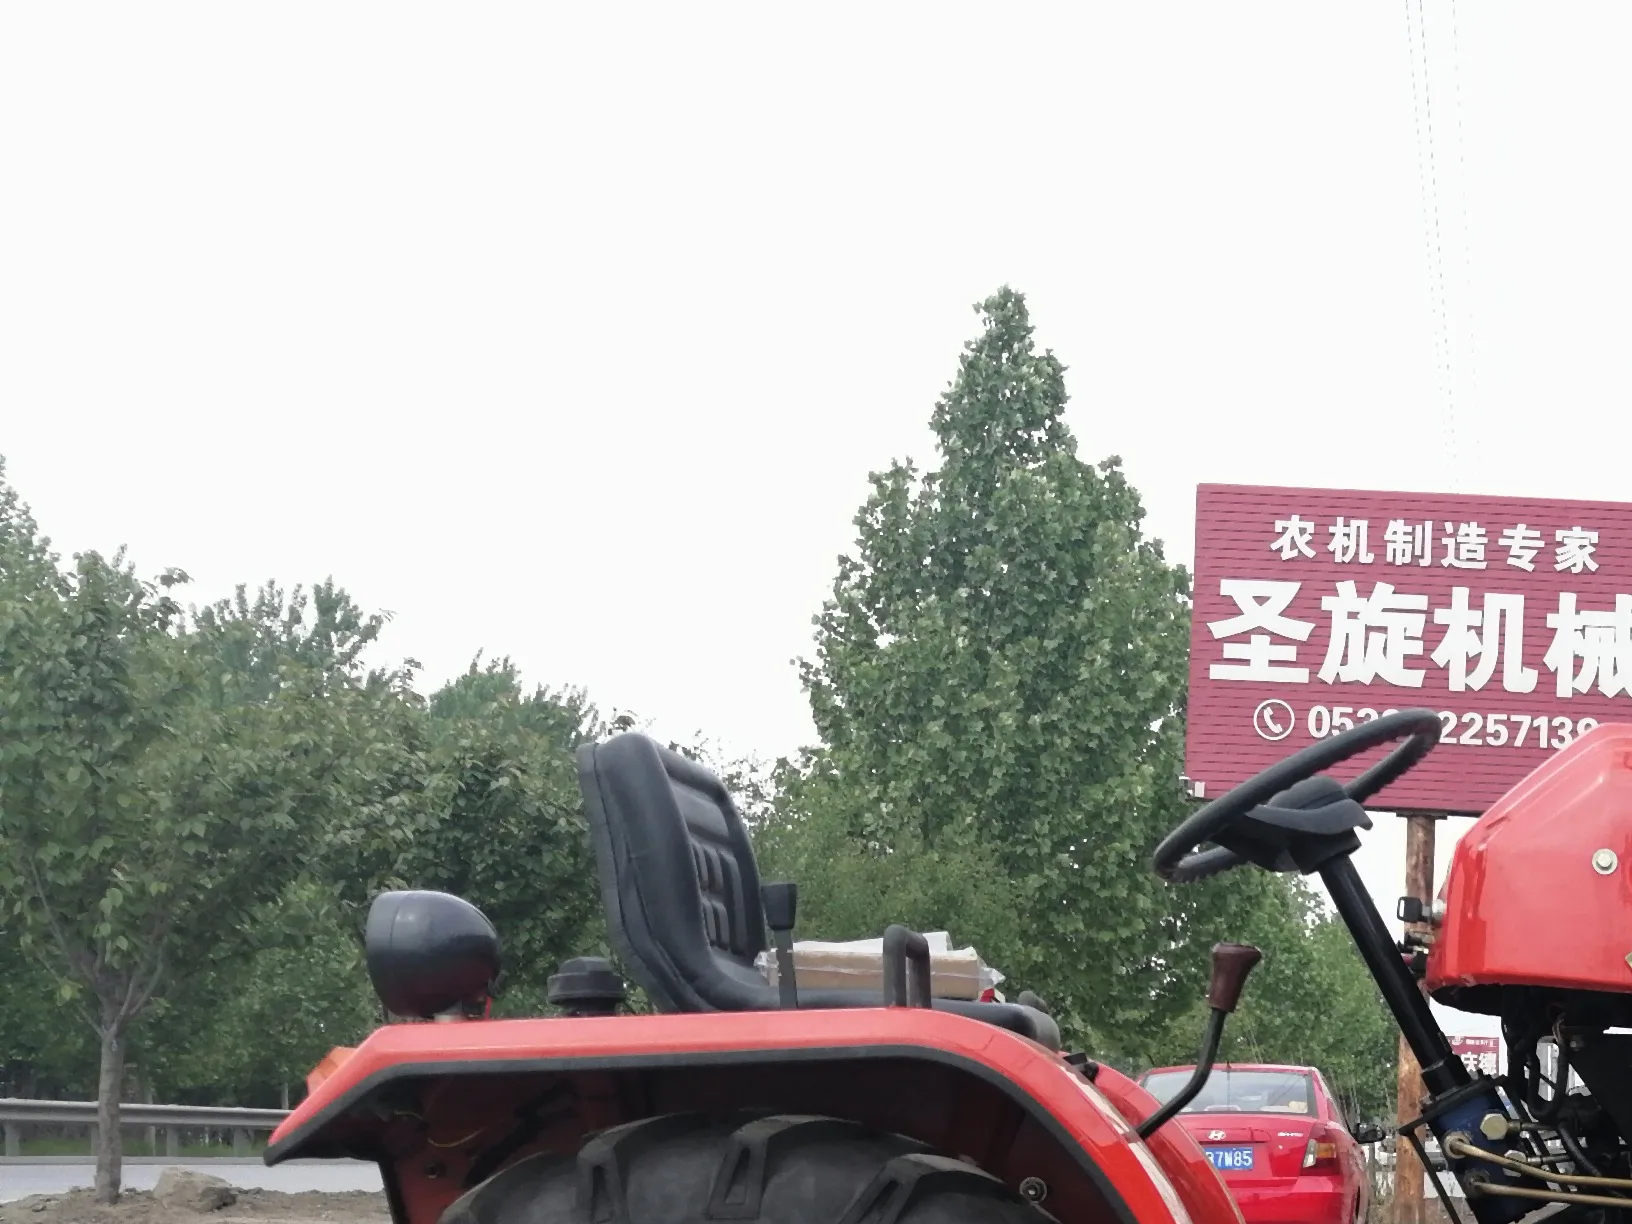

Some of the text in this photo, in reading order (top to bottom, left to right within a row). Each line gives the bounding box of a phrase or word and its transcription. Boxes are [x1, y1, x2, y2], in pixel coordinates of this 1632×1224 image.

[1269, 514, 1600, 574] 农机制造专家
